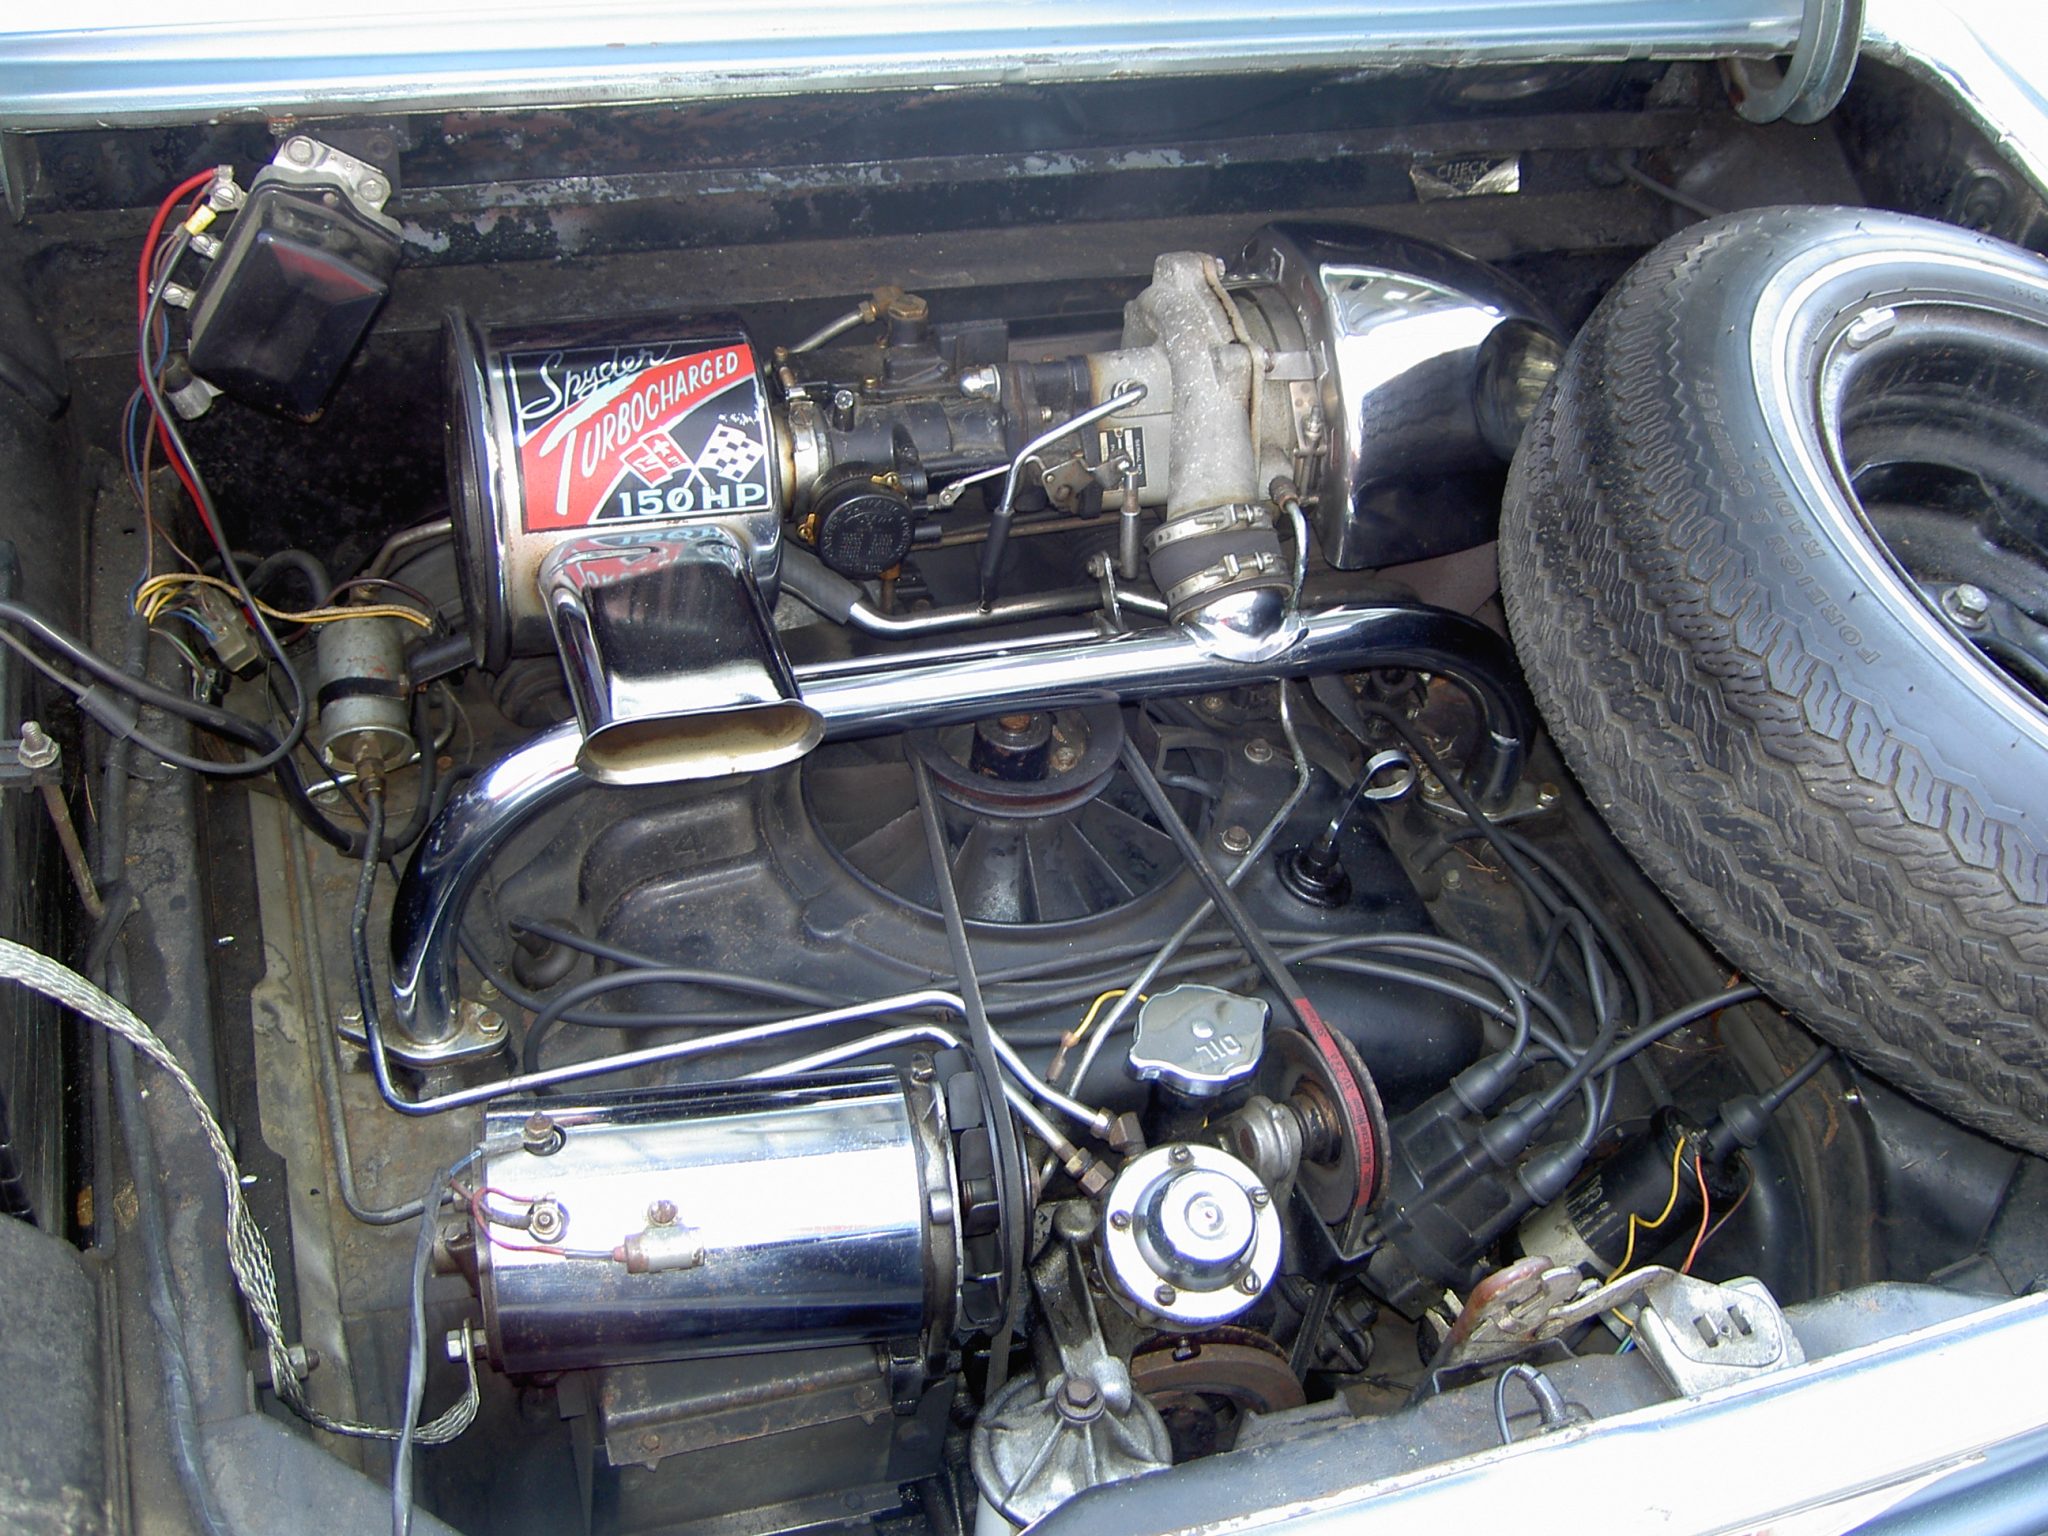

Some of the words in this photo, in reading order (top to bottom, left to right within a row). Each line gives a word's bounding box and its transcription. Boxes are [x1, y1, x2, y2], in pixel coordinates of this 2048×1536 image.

[1437, 160, 1489, 179] CHECK
[520, 344, 672, 419] Spyder
[539, 352, 739, 516] TURBOCHARGED
[619, 487, 694, 516] 150
[702, 483, 765, 510] HP
[1753, 456, 1827, 560] RADIAL
[1765, 533, 1881, 665] FOREIGN
